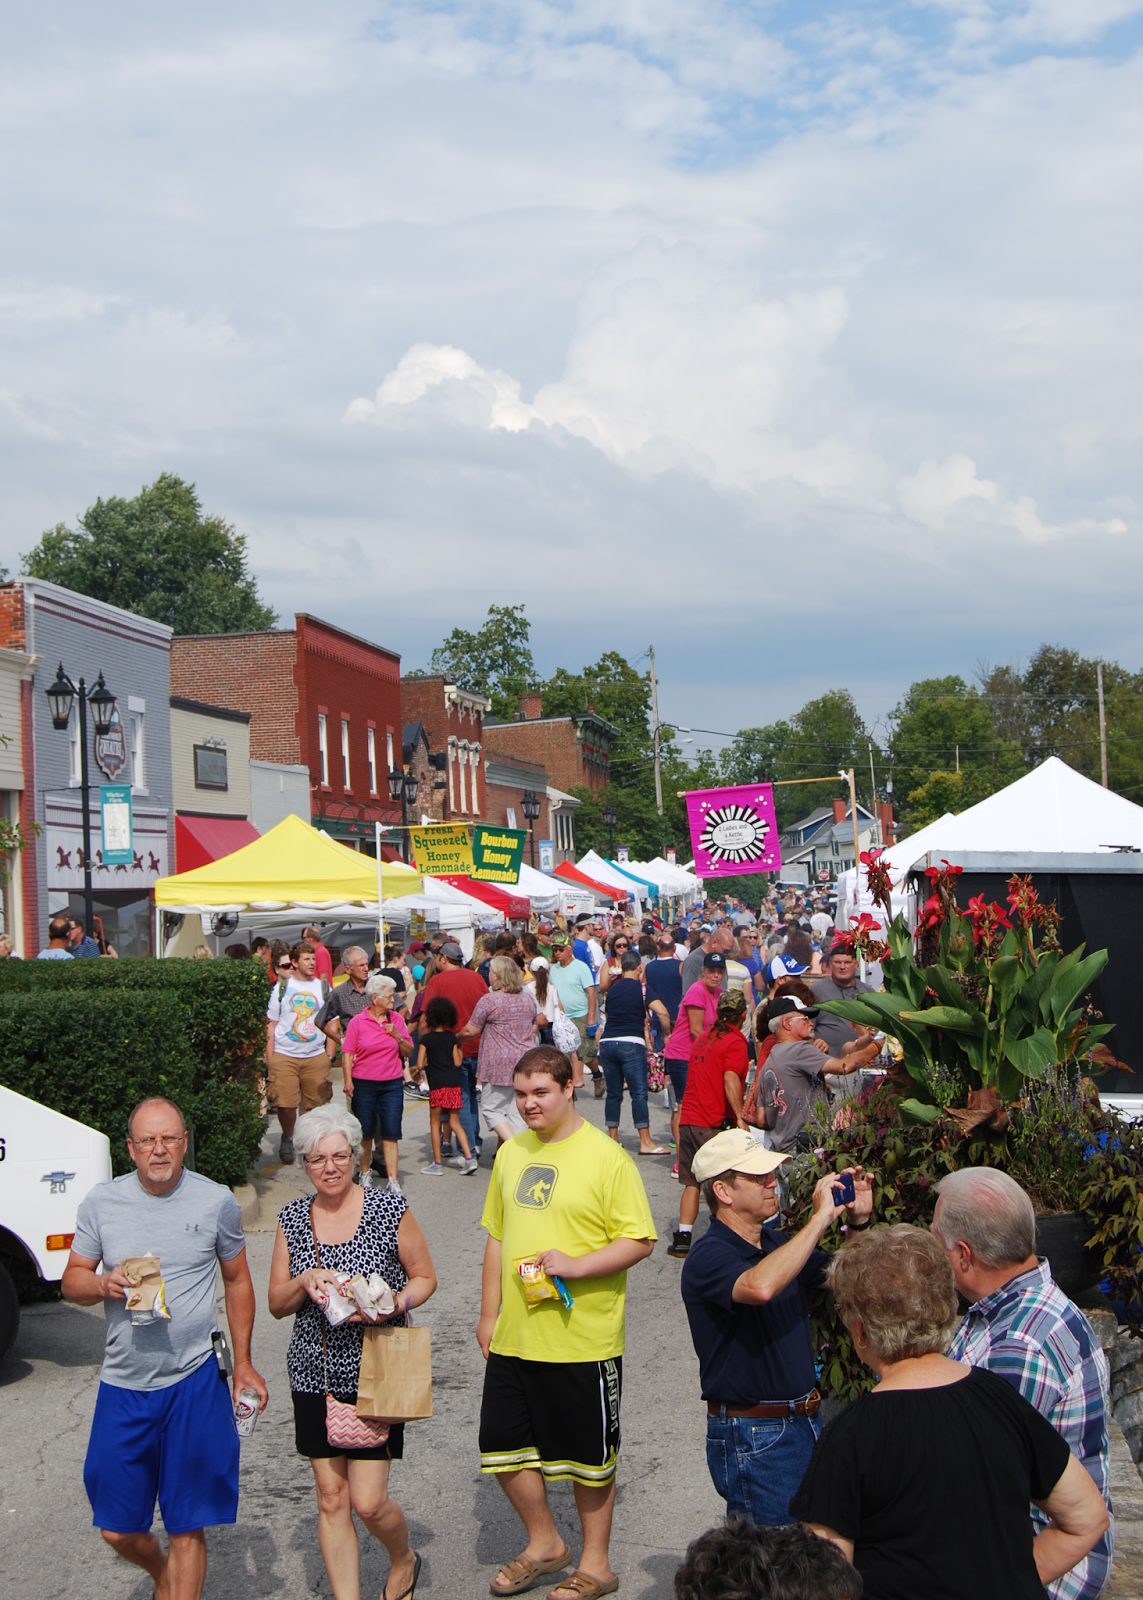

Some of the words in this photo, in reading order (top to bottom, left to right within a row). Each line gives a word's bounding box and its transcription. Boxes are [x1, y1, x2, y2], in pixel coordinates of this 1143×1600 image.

[414, 832, 468, 850] Squeezed
[481, 832, 518, 849] Bourbon
[426, 851, 461, 862] Honey
[483, 849, 511, 868] Honey
[419, 862, 471, 874] Lemonade
[471, 864, 518, 883] Lemonade
[50, 1183, 66, 1194] 20
[521, 1263, 542, 1276] Lays
